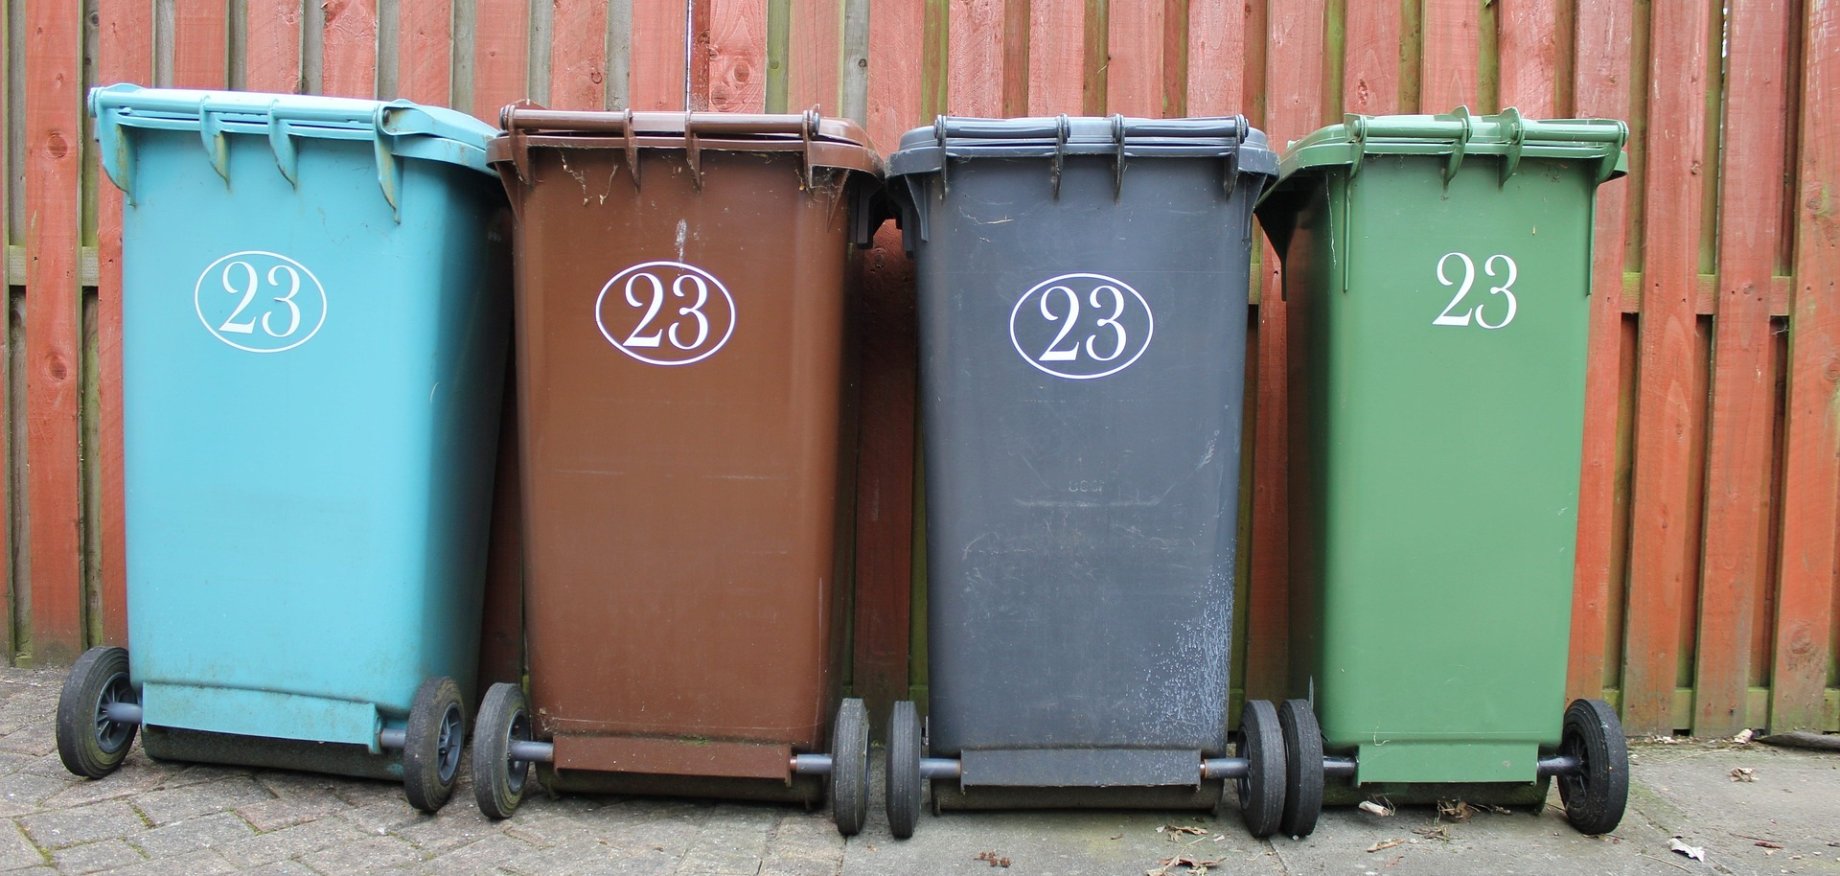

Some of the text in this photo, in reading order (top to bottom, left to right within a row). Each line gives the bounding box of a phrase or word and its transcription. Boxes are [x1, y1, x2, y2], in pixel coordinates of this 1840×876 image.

[219, 262, 301, 337] 23
[623, 273, 708, 349] 23
[1039, 286, 1127, 361] 23
[1433, 253, 1518, 329] 23
